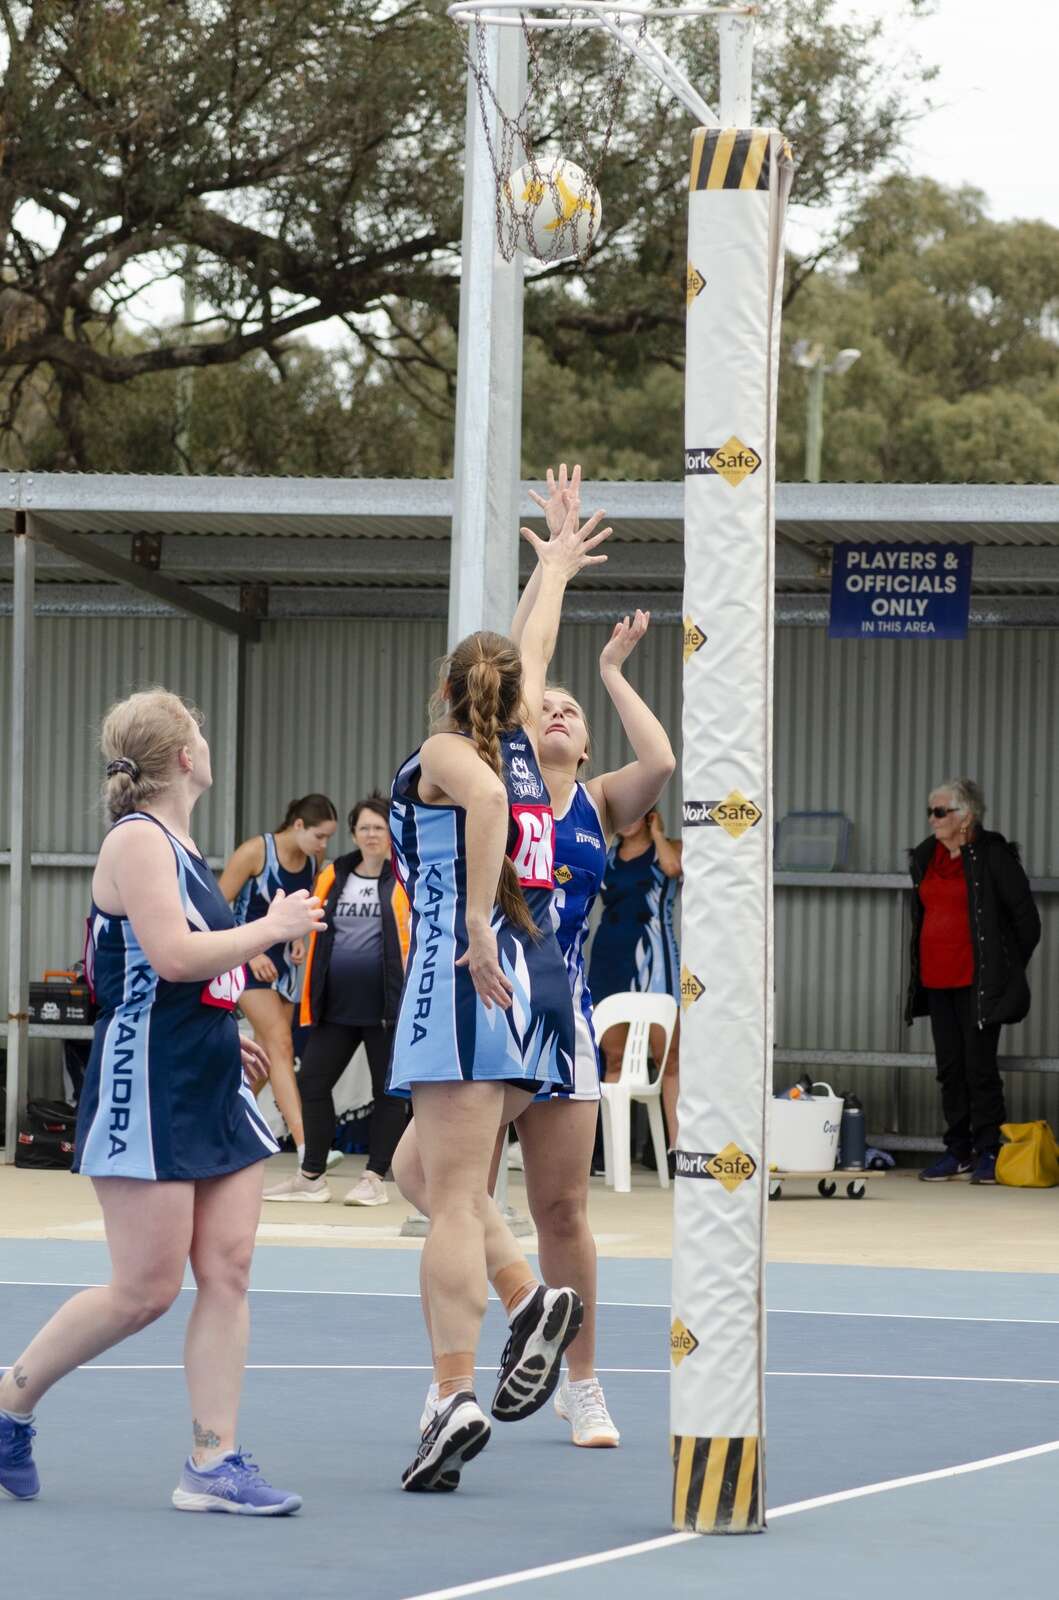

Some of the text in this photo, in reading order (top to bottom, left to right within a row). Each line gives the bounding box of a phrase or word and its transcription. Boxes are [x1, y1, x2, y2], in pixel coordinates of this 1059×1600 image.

[687, 272, 699, 290] afe
[685, 450, 755, 469] ork Safe
[846, 551, 959, 570] PLAYERS &
[846, 575, 957, 593] OFFICIALS
[871, 598, 929, 617] ONLY
[861, 621, 936, 633] IN THIS AREA
[684, 628, 698, 645] afe
[717, 803, 756, 820] Safe
[410, 862, 444, 1047] KATANDRA
[681, 977, 698, 996] afe
[108, 964, 152, 1160] KATANDRA
[712, 1156, 751, 1174] Safe
[671, 1331, 691, 1349] afe
